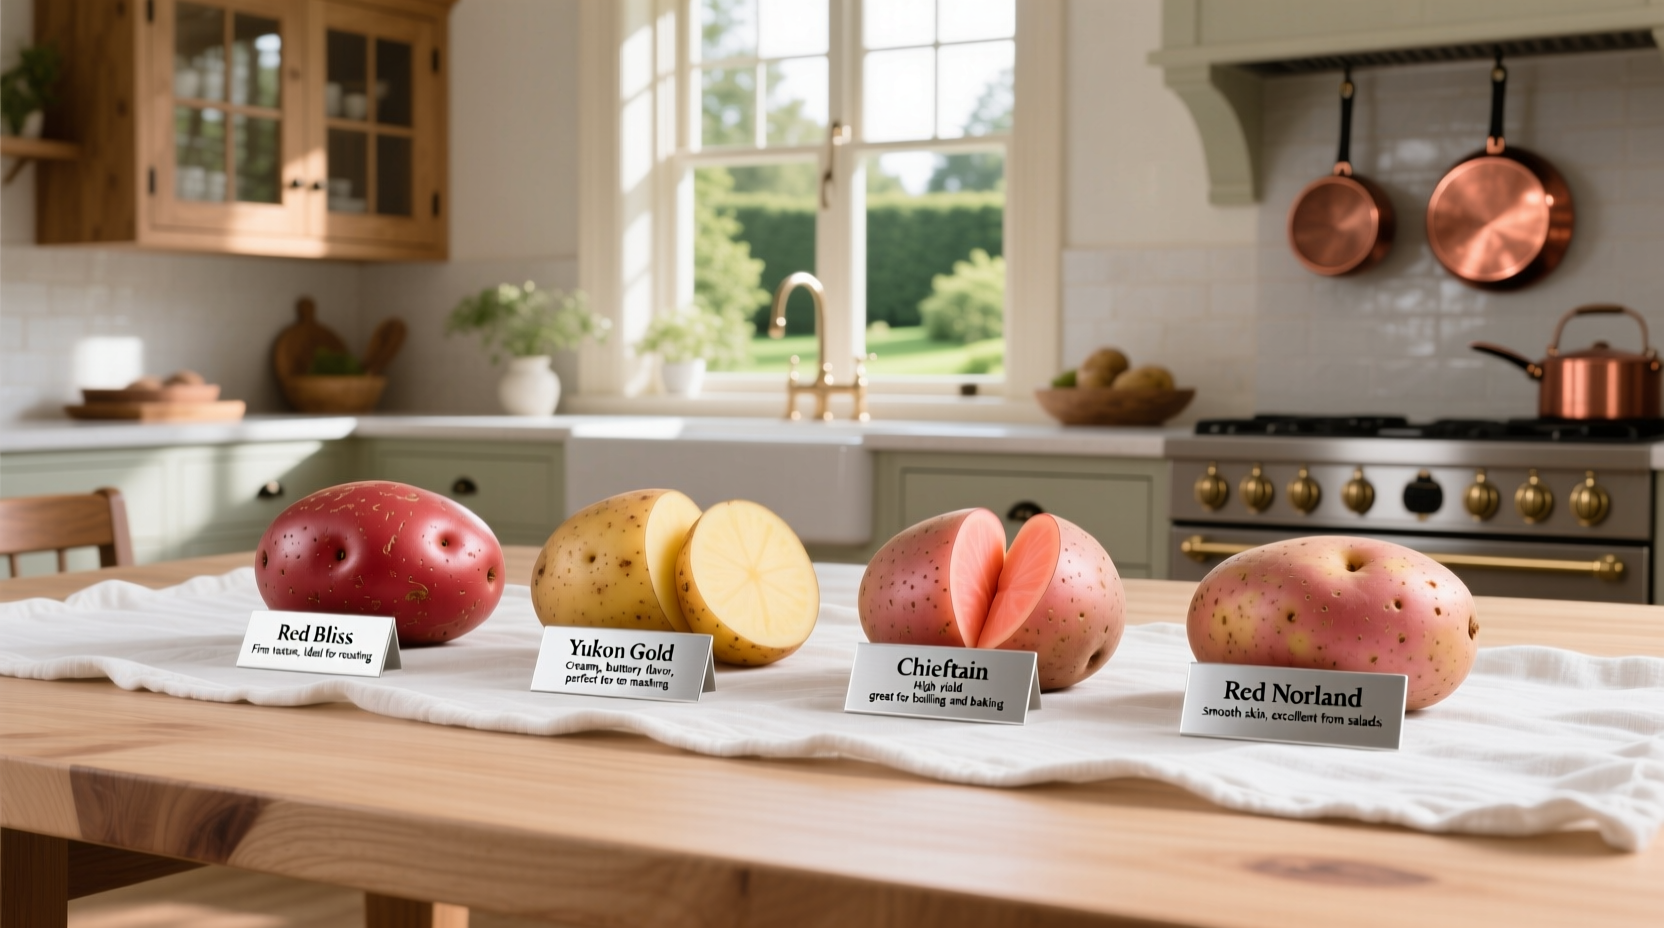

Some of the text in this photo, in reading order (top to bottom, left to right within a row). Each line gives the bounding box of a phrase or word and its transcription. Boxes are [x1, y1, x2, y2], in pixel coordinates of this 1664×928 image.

[277, 623, 354, 645] Red Bliss
[569, 638, 675, 662] Yukon Gold
[565, 674, 598, 685] perfect
[897, 656, 989, 681] Chieftain
[869, 692, 894, 702] great
[970, 696, 1004, 711] baking
[1223, 680, 1363, 708] Red Norland
[1321, 712, 1344, 725] from
[1347, 714, 1383, 728] salads
